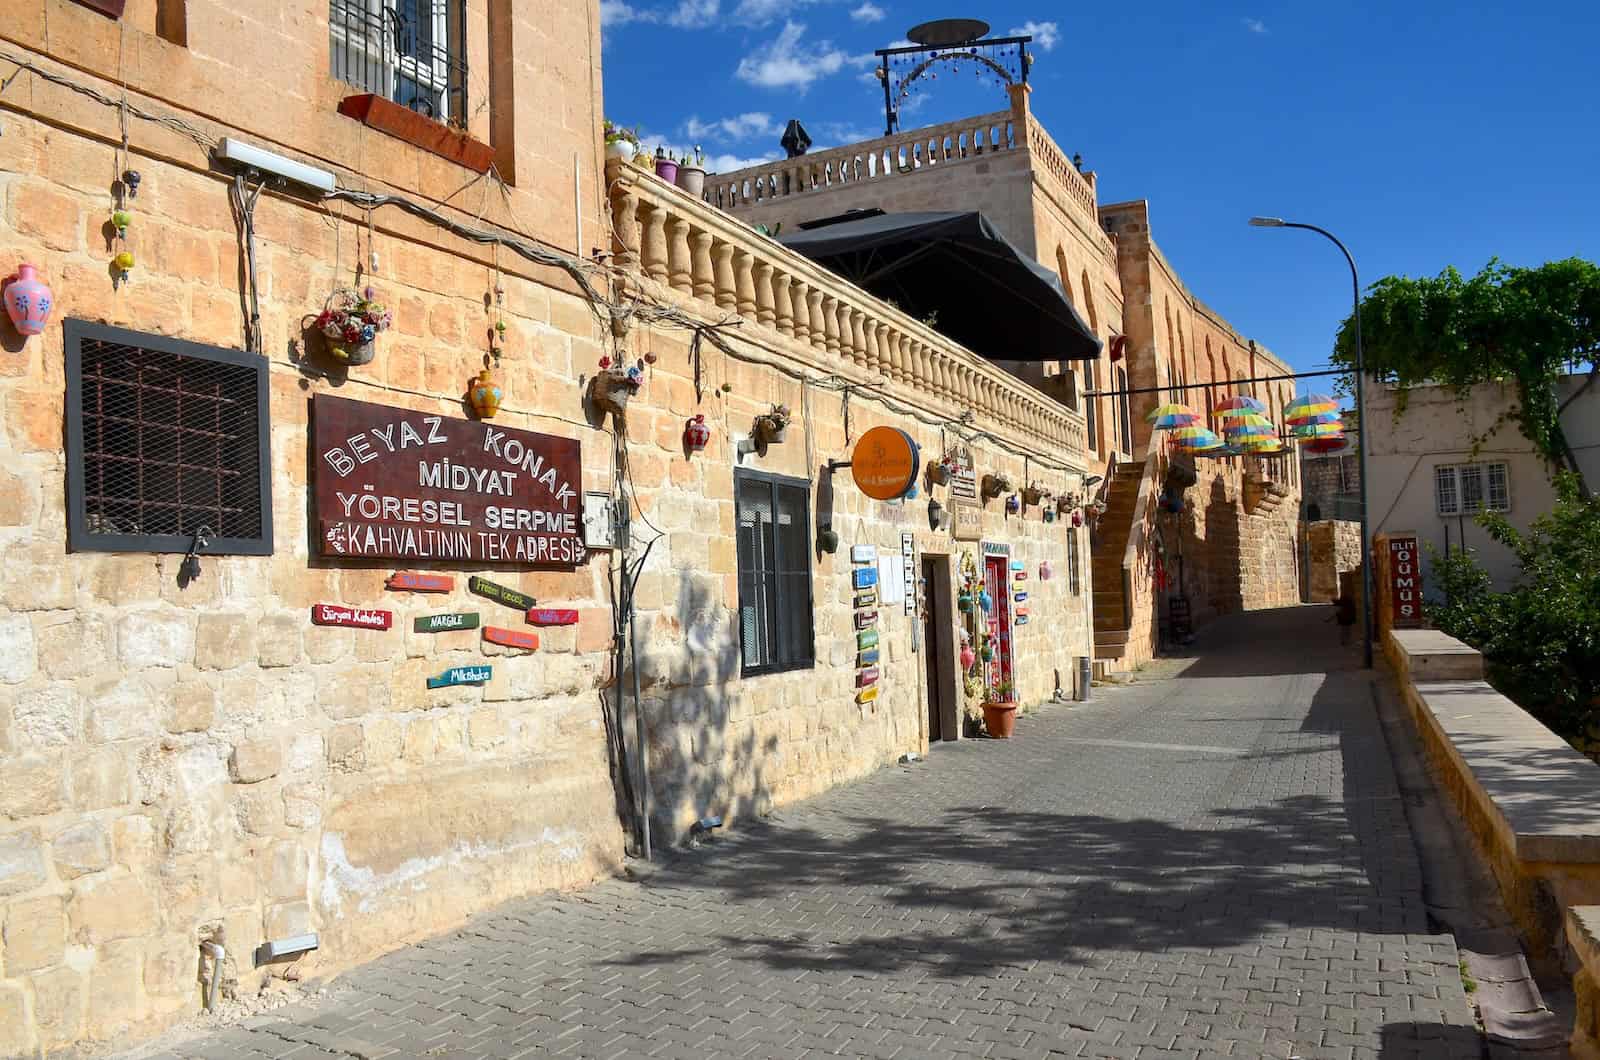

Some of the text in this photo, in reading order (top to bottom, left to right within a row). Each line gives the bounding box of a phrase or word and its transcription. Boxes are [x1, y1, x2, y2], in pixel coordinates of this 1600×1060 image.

[324, 416, 577, 510] BEYAZ KONAK
[419, 457, 517, 497] MİDYAT
[336, 484, 577, 534] YÖRESEL SERPME
[347, 524, 576, 563] KAHVALTININ TEK ADRESİ
